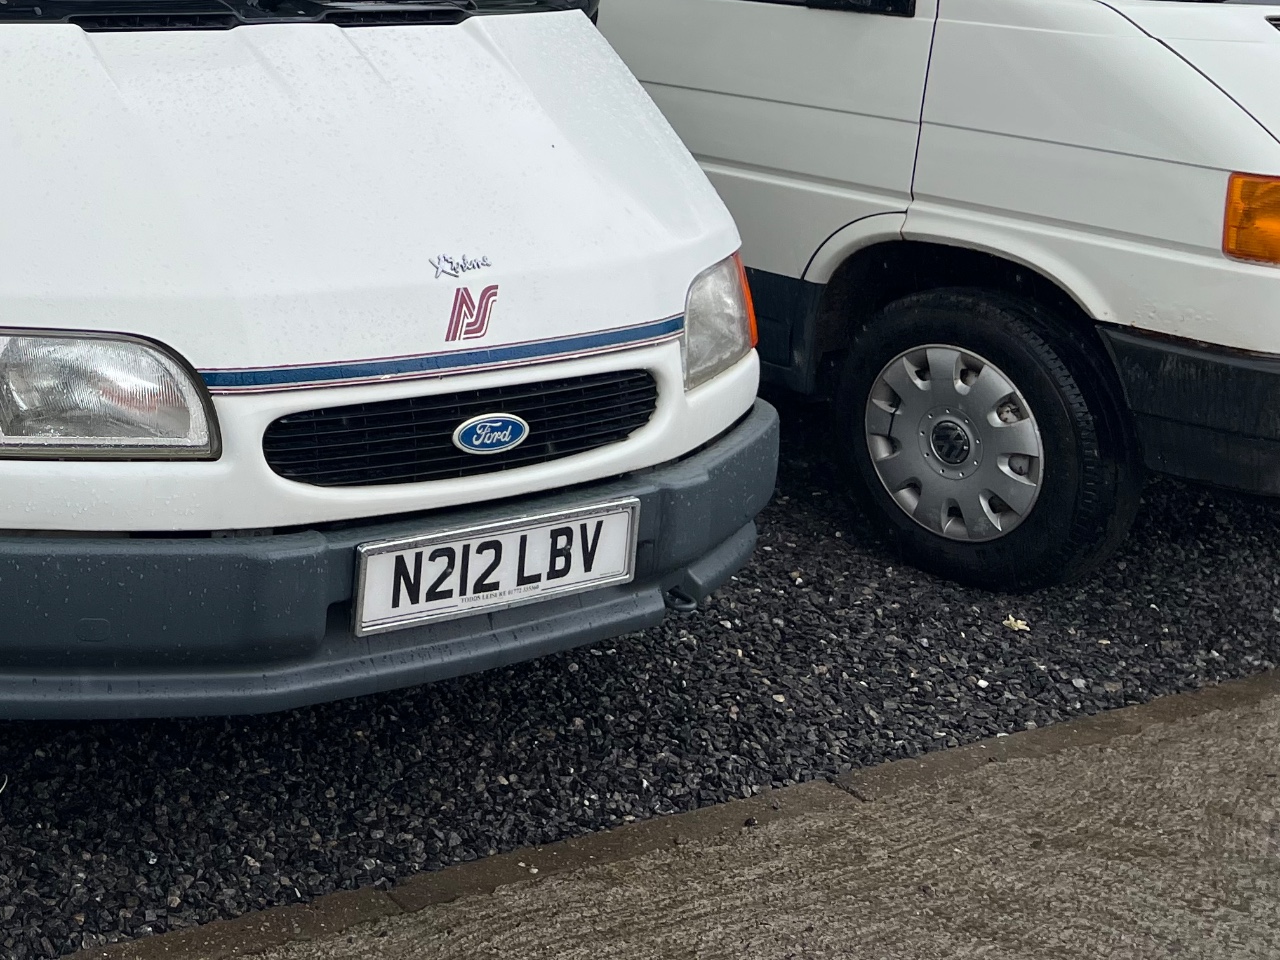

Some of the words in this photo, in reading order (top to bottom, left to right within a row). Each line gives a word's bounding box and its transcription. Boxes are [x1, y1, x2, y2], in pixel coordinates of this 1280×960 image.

[472, 422, 512, 445] Ford
[391, 539, 503, 608] N212
[516, 520, 604, 587] LBV
